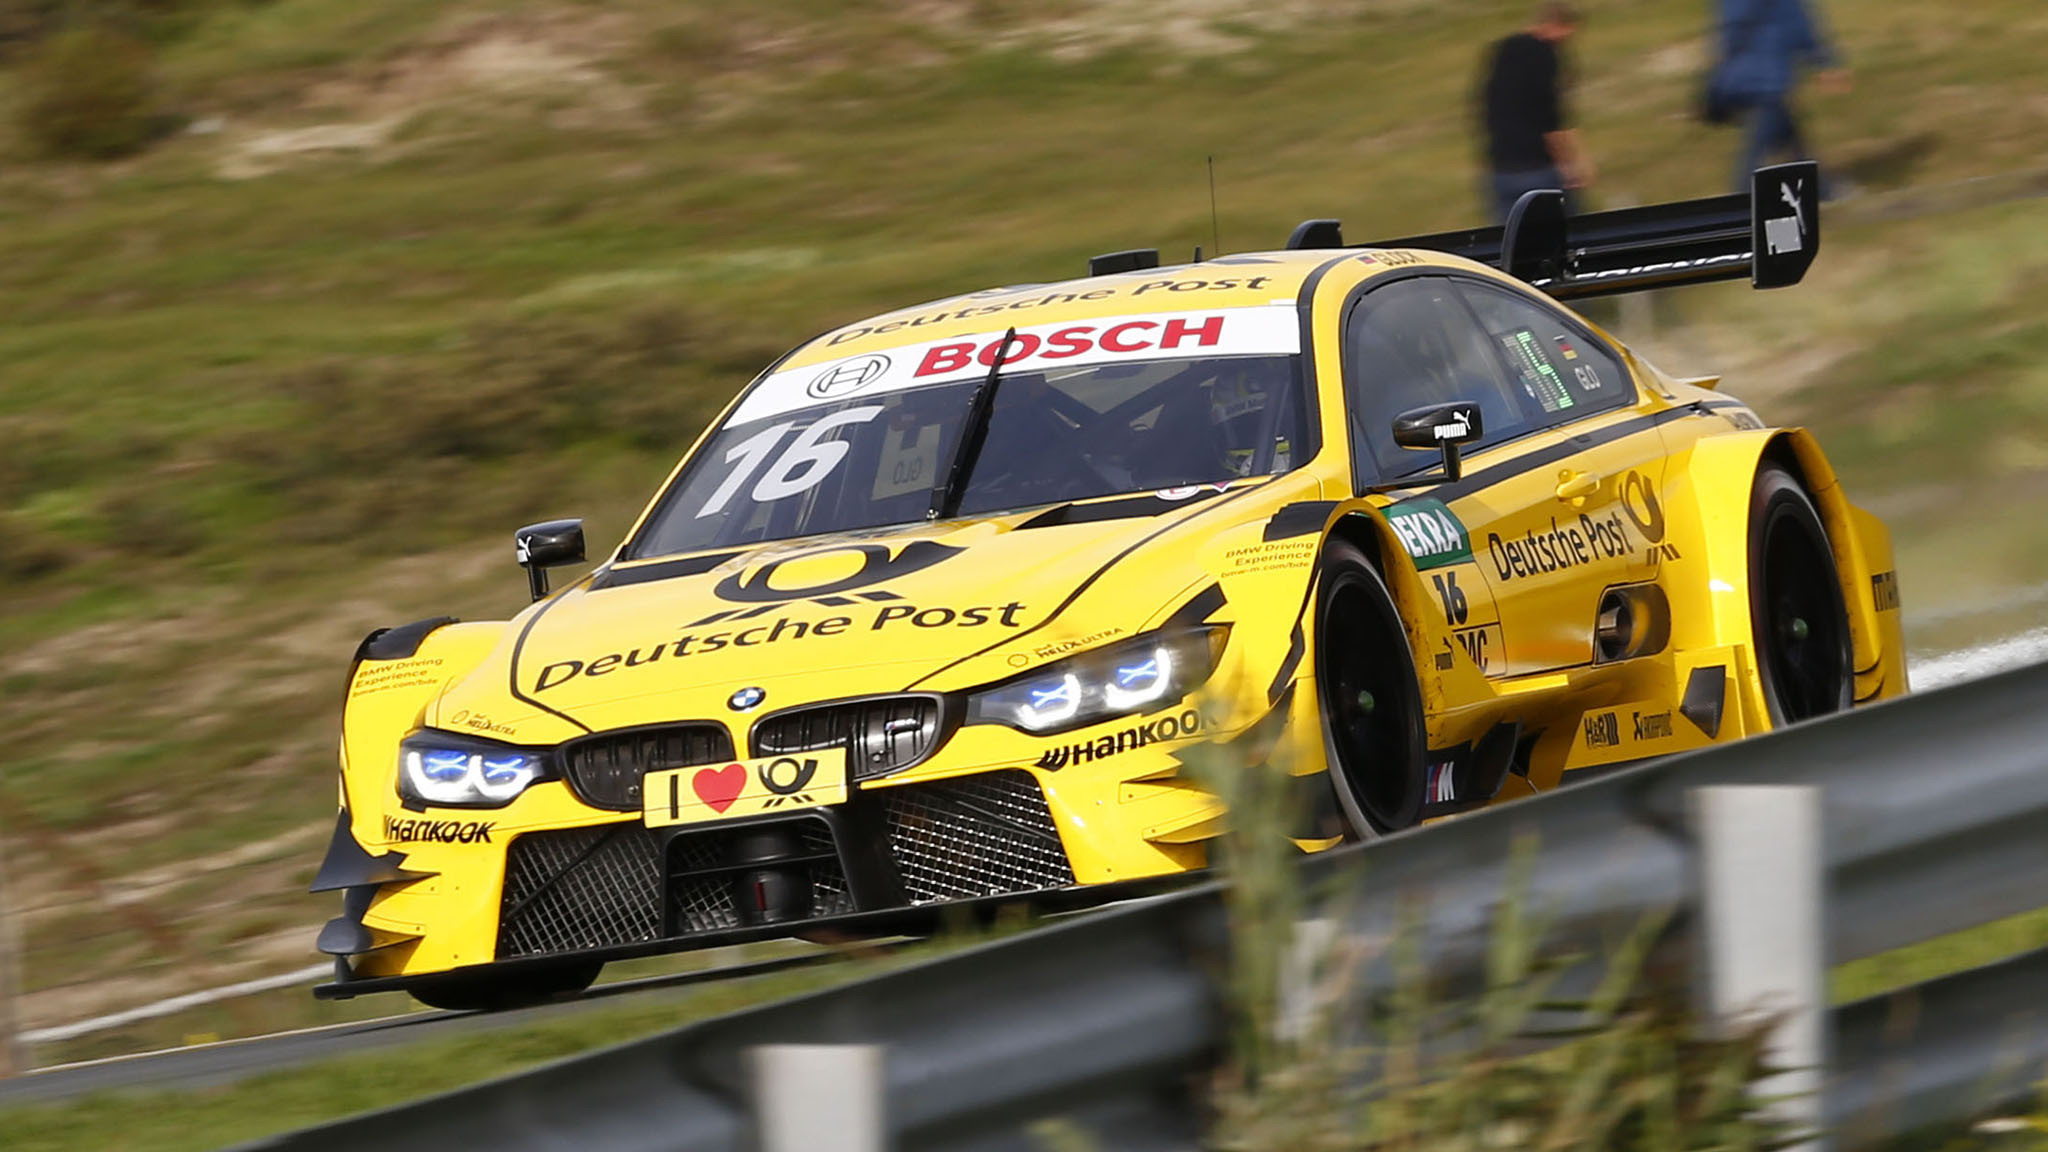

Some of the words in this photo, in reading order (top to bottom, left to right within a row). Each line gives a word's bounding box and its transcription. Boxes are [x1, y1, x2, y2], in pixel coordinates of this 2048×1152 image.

[827, 287, 1116, 347] Deutsche
[1134, 275, 1273, 296] Post
[912, 315, 1225, 378] BOSCH
[694, 404, 886, 519] 16
[1225, 545, 1262, 559] BMW
[1264, 541, 1315, 552] Driving
[1235, 551, 1312, 567] Experience
[1488, 516, 1590, 581] Deutsche
[1579, 511, 1634, 560] Post
[1432, 571, 1468, 626] 16
[358, 664, 393, 679] BMW
[395, 657, 444, 670] Driving
[534, 612, 852, 693] Deutsche
[869, 601, 1026, 632] Post
[355, 670, 428, 688] Experience
